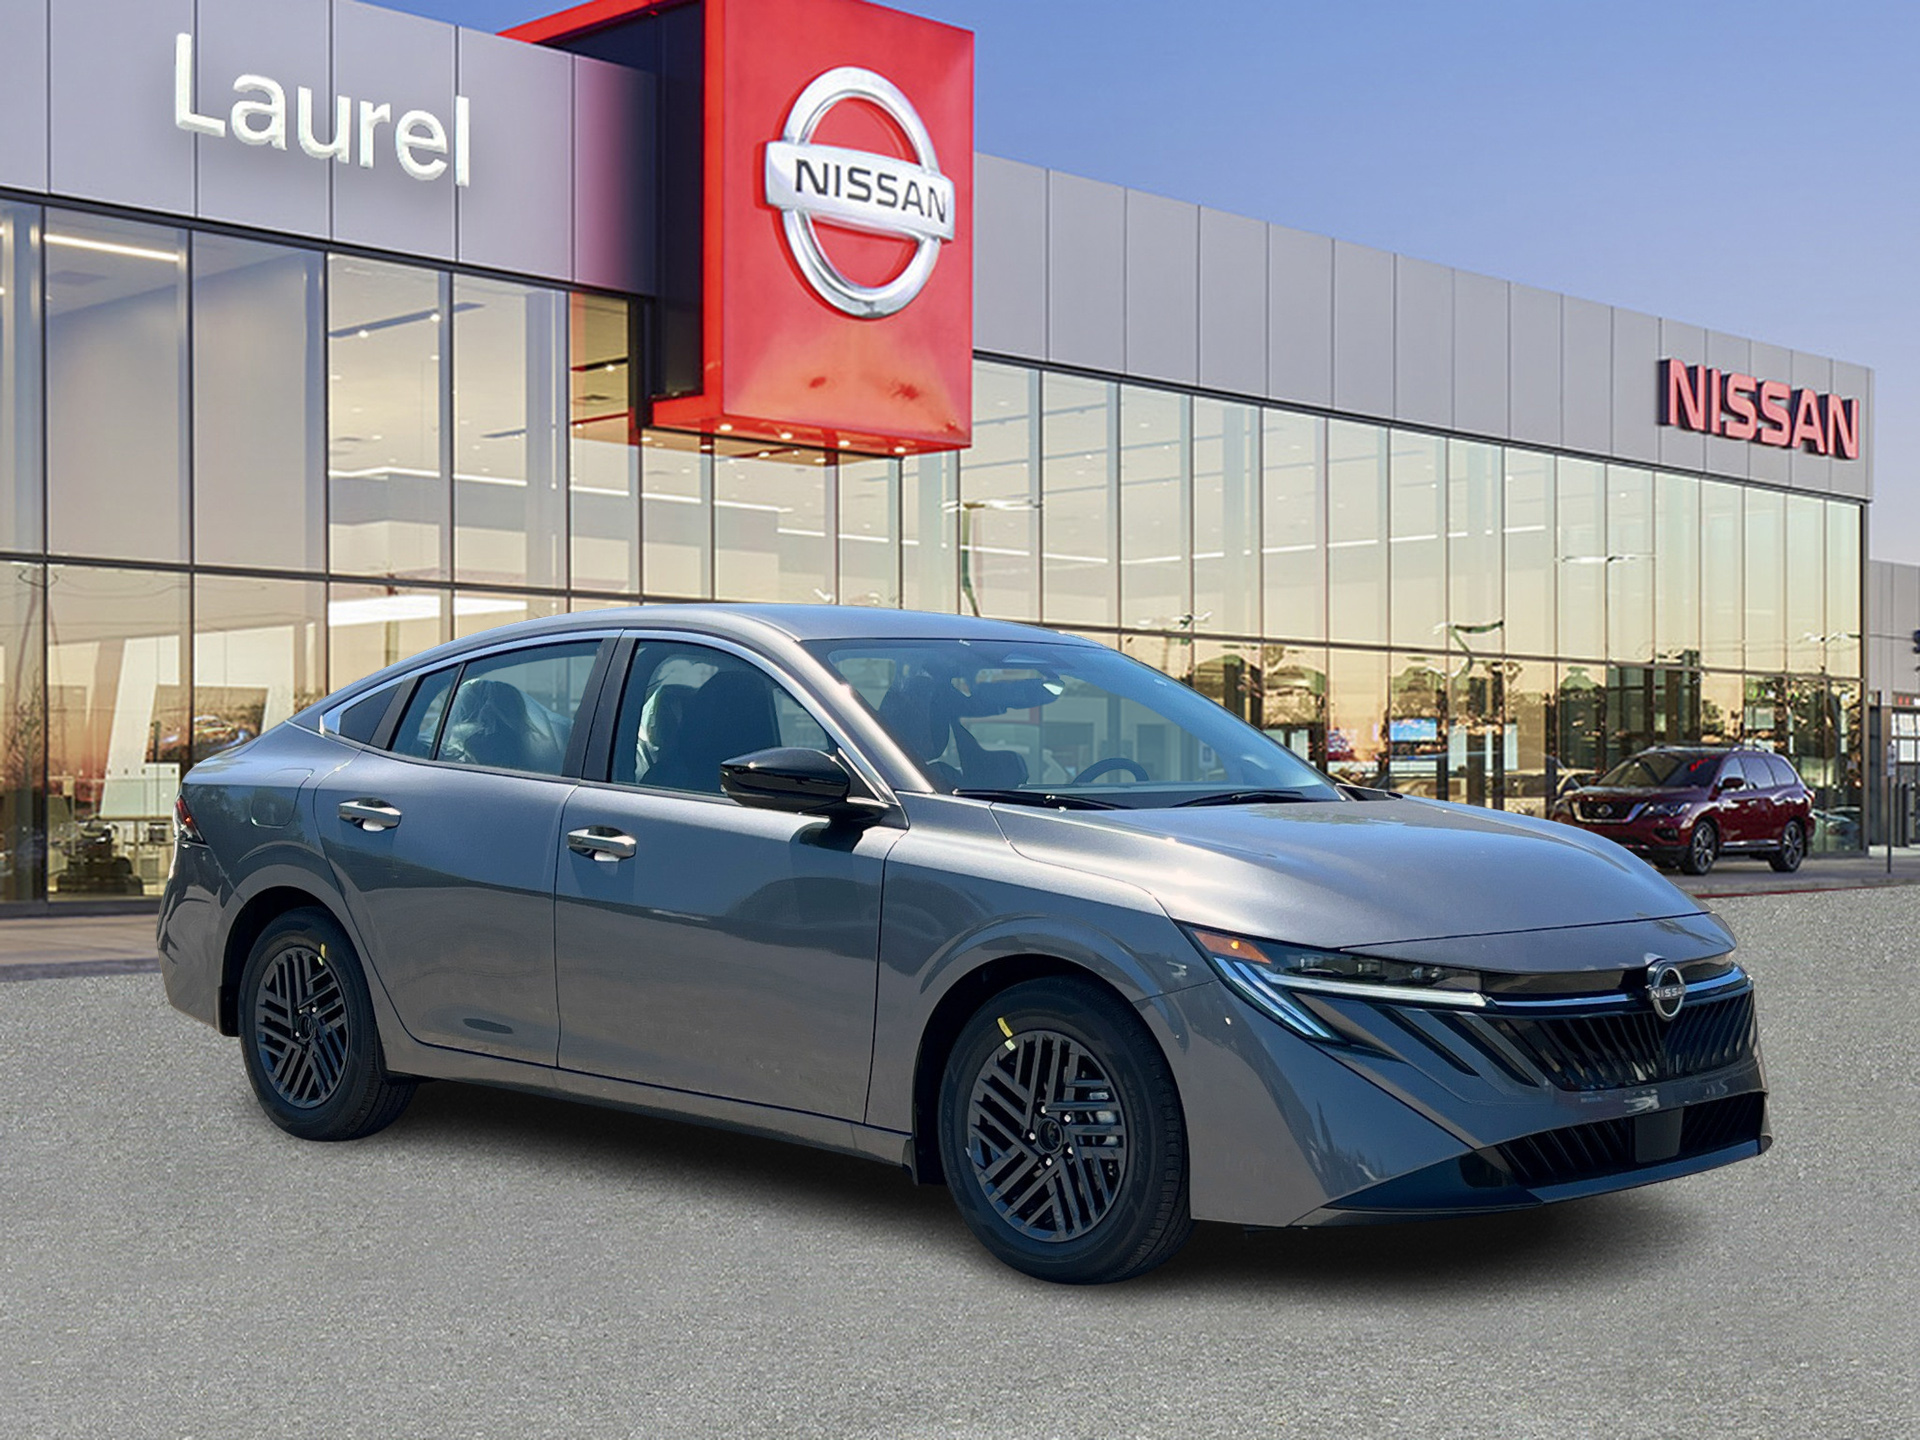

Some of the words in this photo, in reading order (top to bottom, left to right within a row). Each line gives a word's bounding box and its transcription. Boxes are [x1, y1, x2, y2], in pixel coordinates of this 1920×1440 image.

[175, 33, 469, 187] Laurel
[795, 158, 946, 224] NISSAN
[1664, 358, 1859, 460] NISSAN
[1651, 986, 1685, 999] NISS
